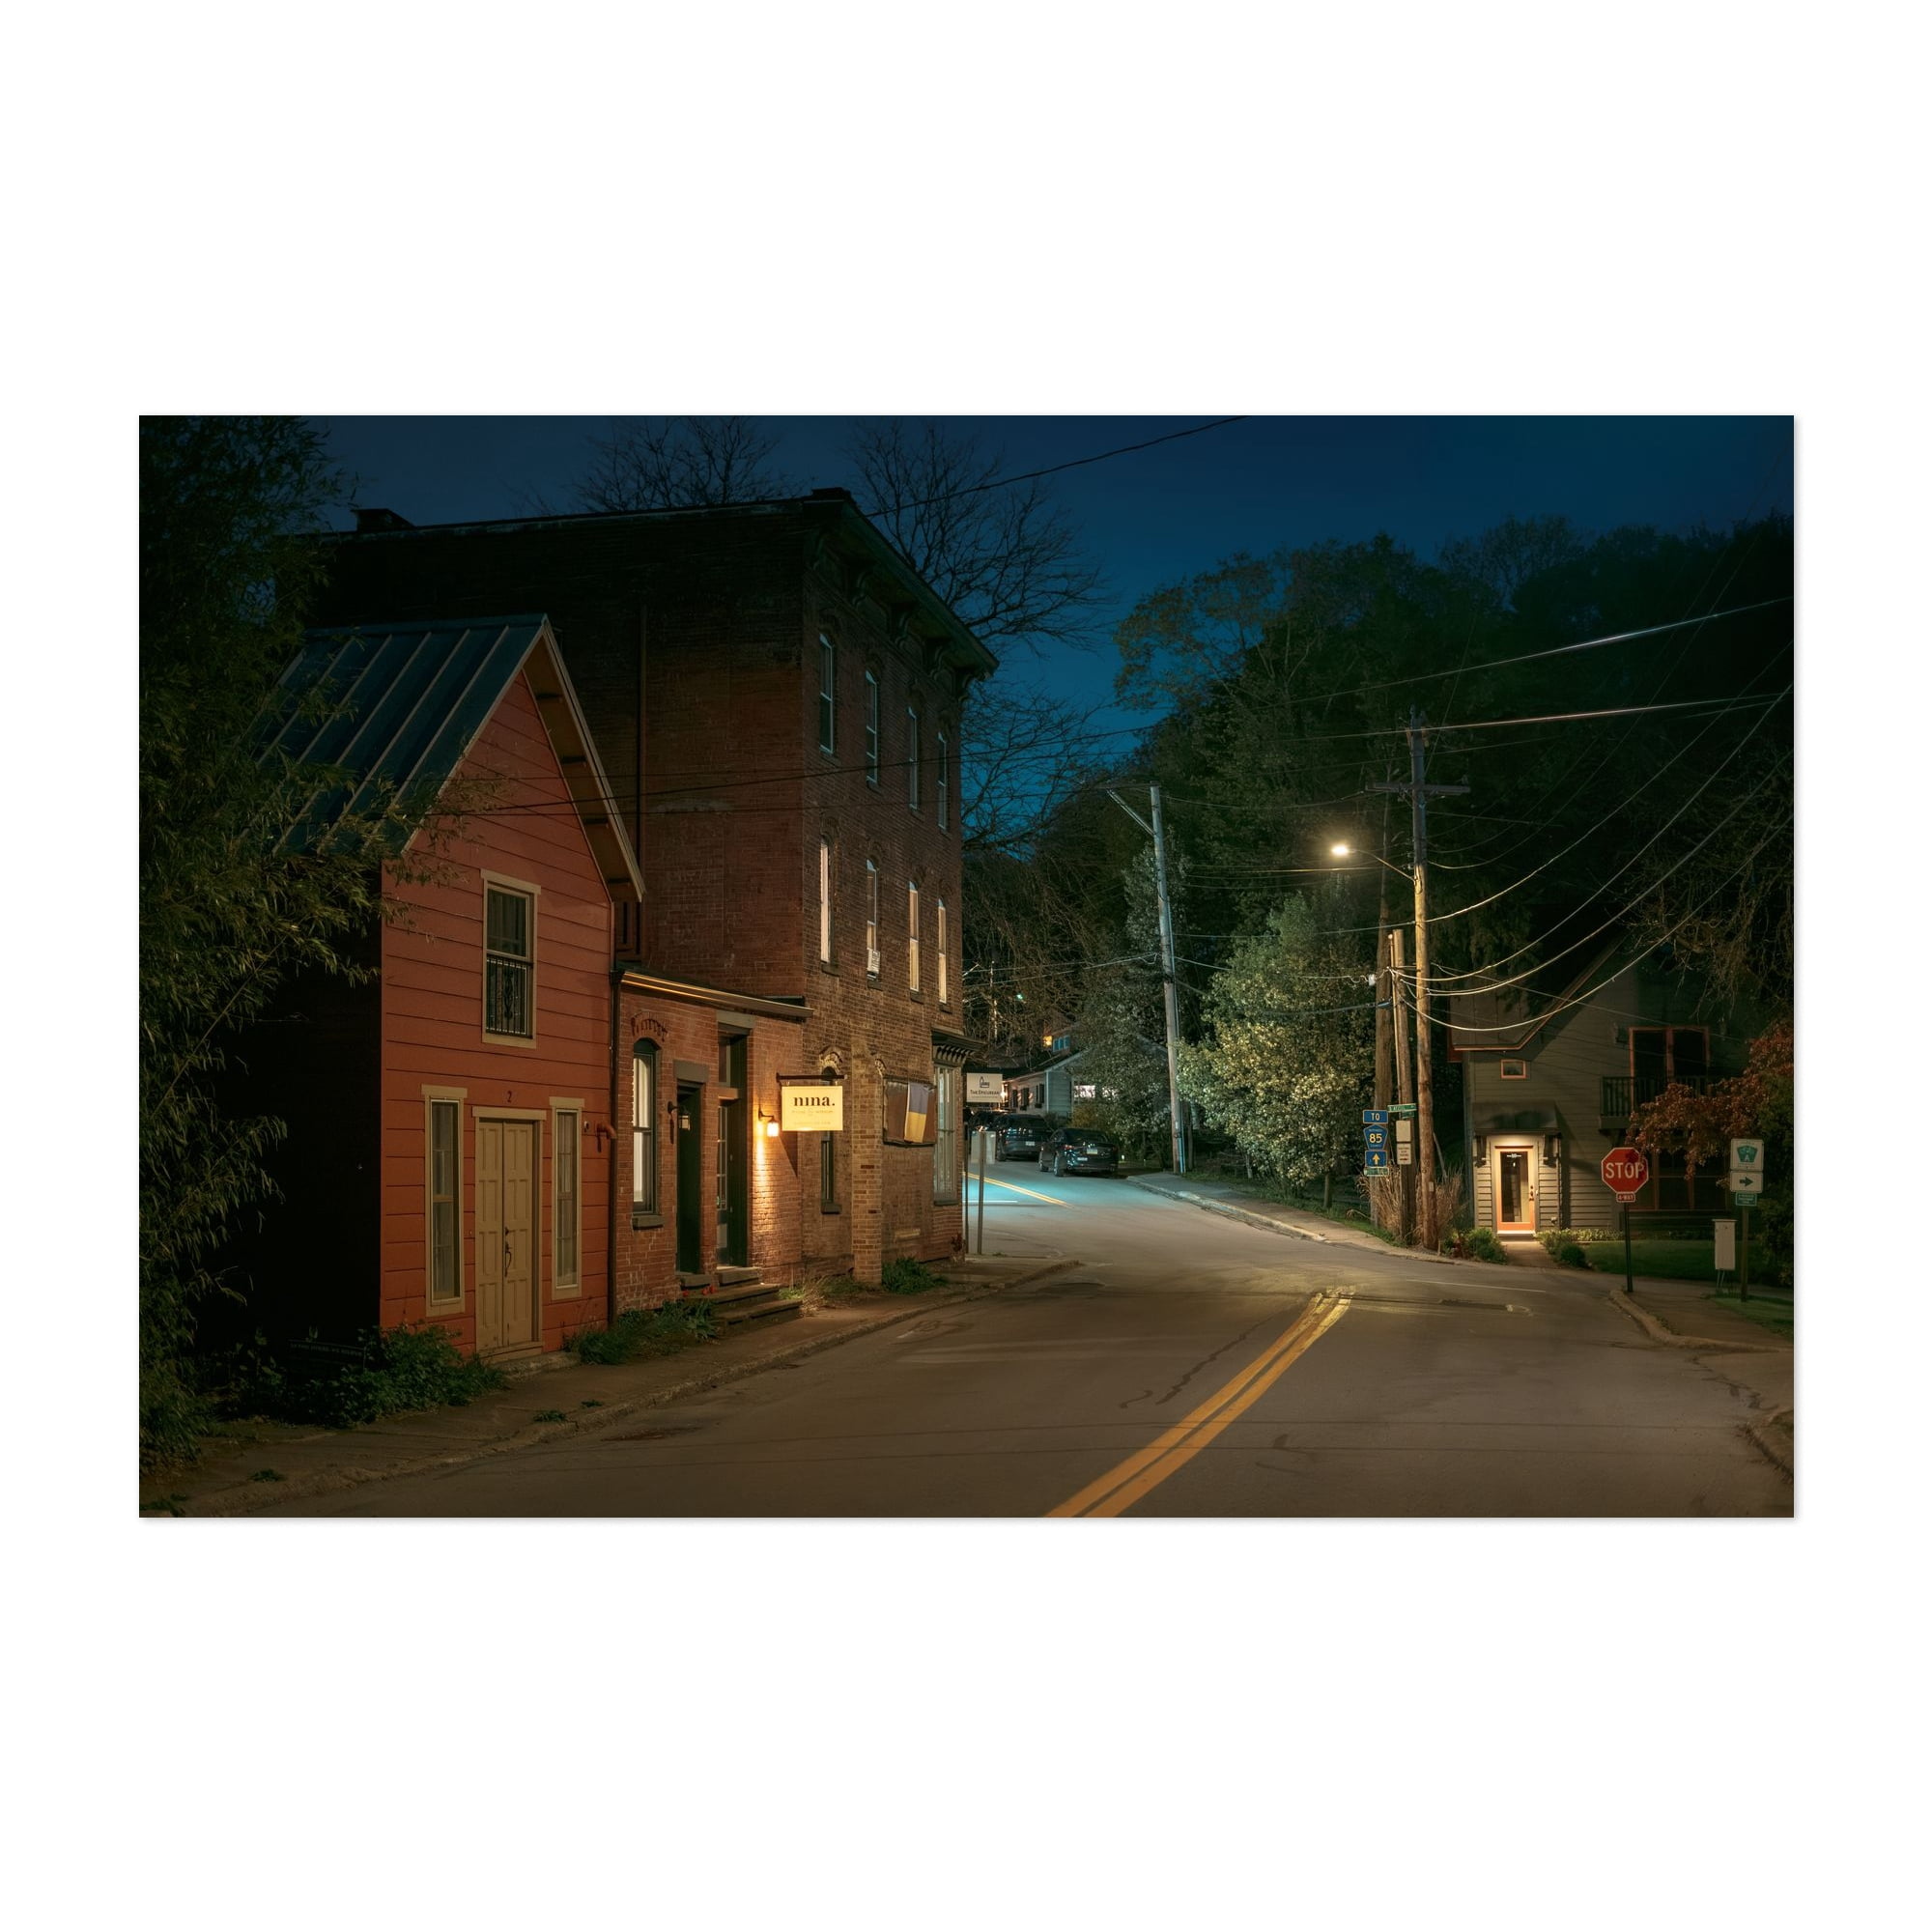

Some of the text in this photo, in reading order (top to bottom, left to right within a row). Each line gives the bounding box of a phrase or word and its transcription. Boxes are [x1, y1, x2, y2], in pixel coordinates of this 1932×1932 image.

[507, 1090, 512, 1103] 2
[1369, 1133, 1382, 1144] 85
[1605, 1162, 1645, 1179] STOP
